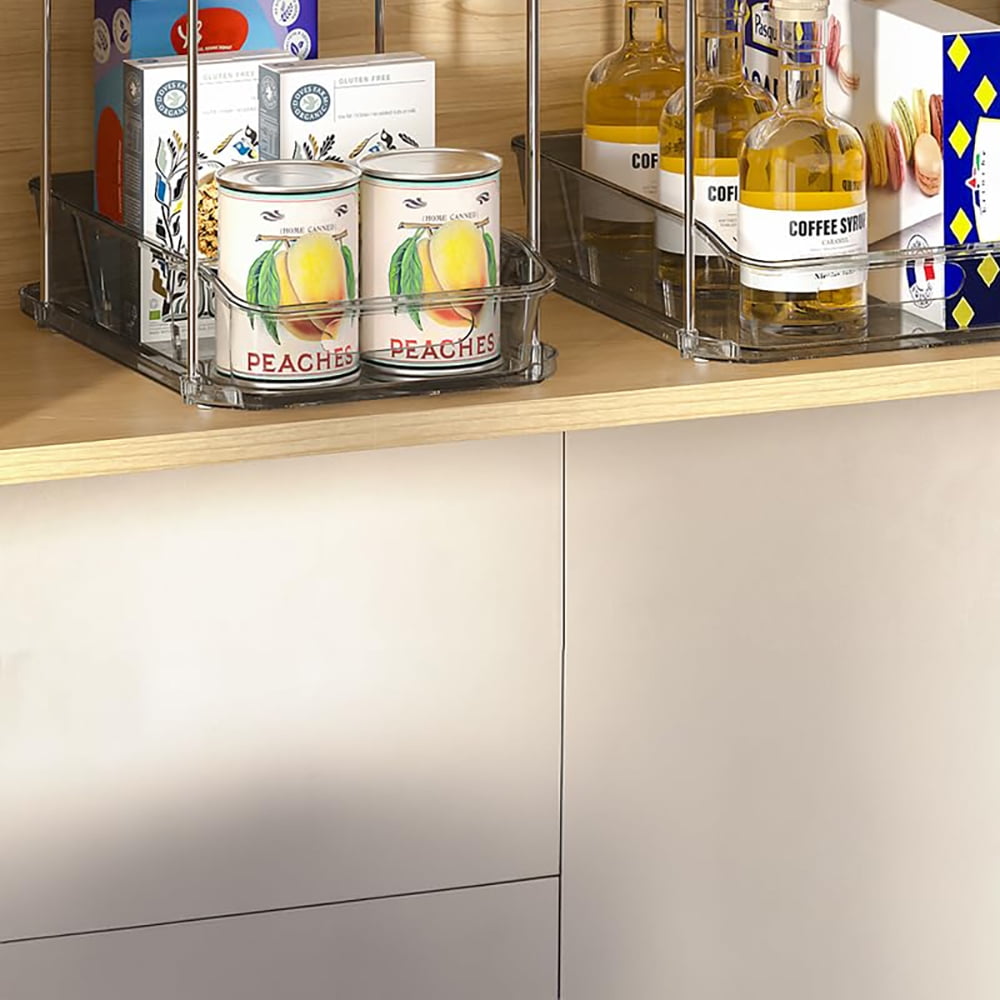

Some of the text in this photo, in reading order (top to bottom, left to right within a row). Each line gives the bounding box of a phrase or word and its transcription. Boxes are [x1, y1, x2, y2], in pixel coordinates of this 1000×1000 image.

[338, 73, 391, 85] GLUTEN FREE
[632, 153, 658, 169] COF
[707, 185, 738, 202] COF
[789, 211, 866, 237] COFFEE SYRU
[389, 333, 496, 360] PEACHES
[247, 345, 354, 374] PEACHES
